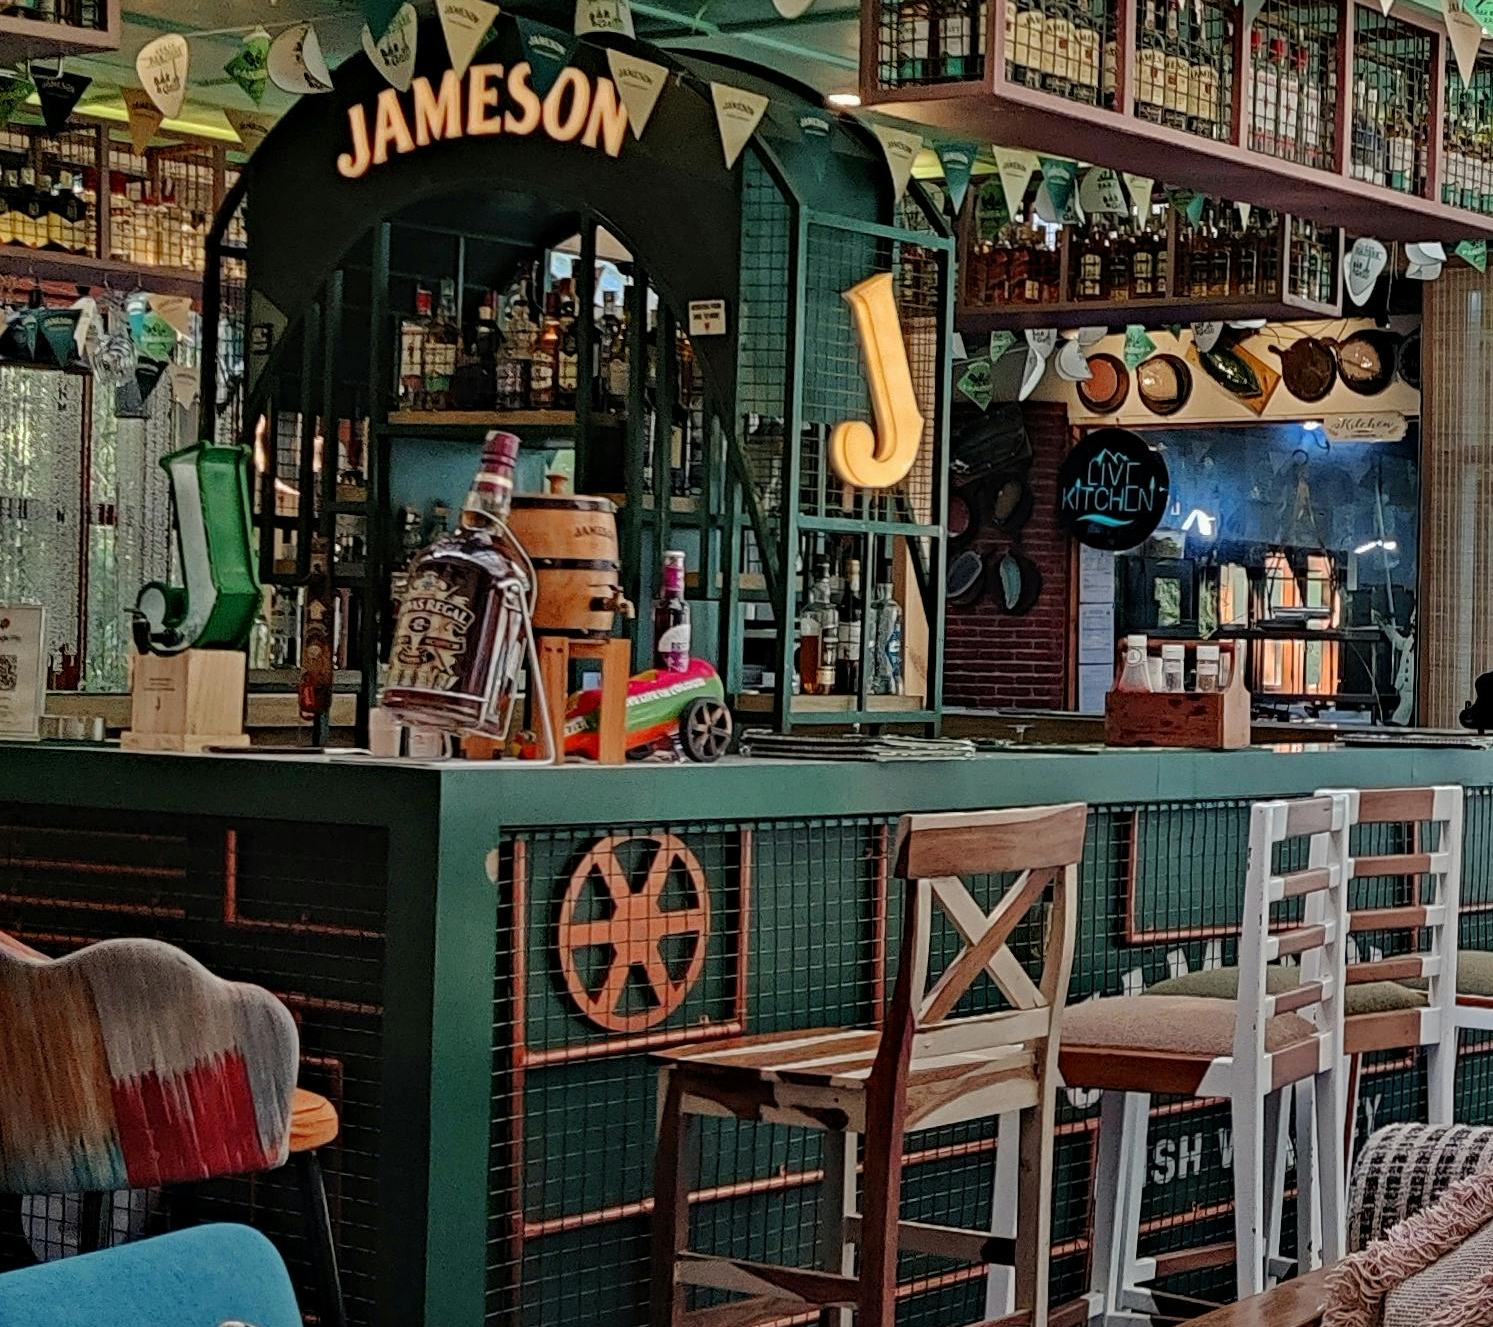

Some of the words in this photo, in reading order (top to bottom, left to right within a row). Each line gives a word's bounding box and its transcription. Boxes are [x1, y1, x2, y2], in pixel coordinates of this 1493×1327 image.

[337, 62, 629, 179] JAMESON
[831, 272, 920, 490] J
[1334, 416, 1393, 431] Kitchen
[1087, 459, 1142, 487] LIVE
[1061, 479, 1156, 512] KITCHEN
[426, 599, 468, 623] REGAL
